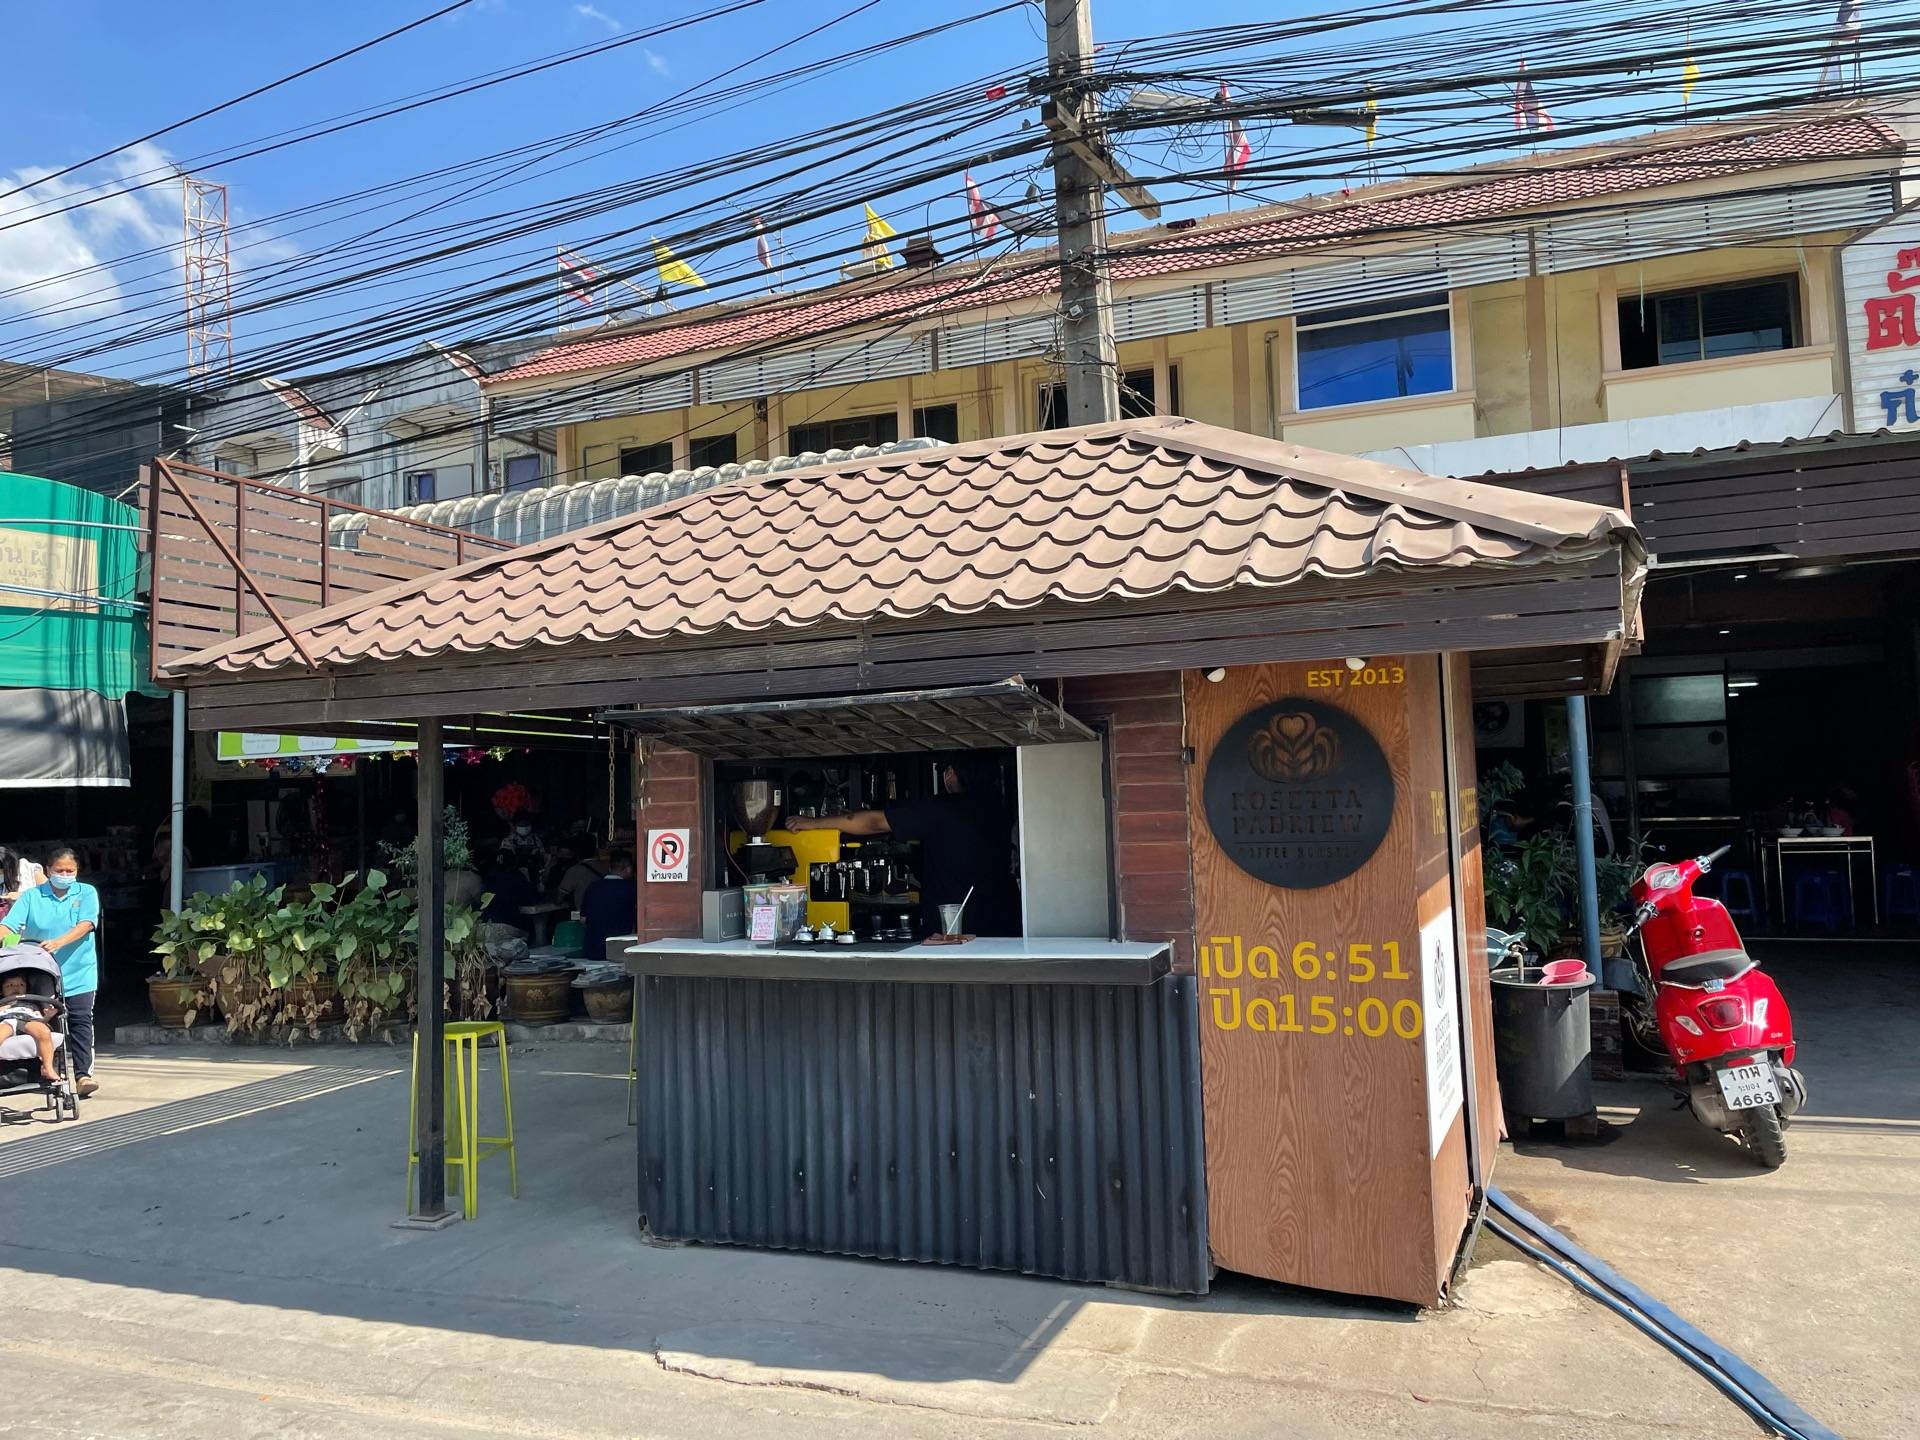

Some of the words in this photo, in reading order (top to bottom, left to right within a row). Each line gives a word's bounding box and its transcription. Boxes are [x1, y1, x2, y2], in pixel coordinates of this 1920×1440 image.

[1307, 670, 1344, 688] EST
[1350, 667, 1404, 686] 2013
[1231, 789, 1363, 811] ROSETTA
[651, 869, 683, 880] ห้ามจอด
[1200, 935, 1279, 979] เปิด
[1292, 940, 1409, 984] 6:51
[1738, 1082, 1761, 1092] ระยอง
[1733, 1091, 1775, 1108] 4663
